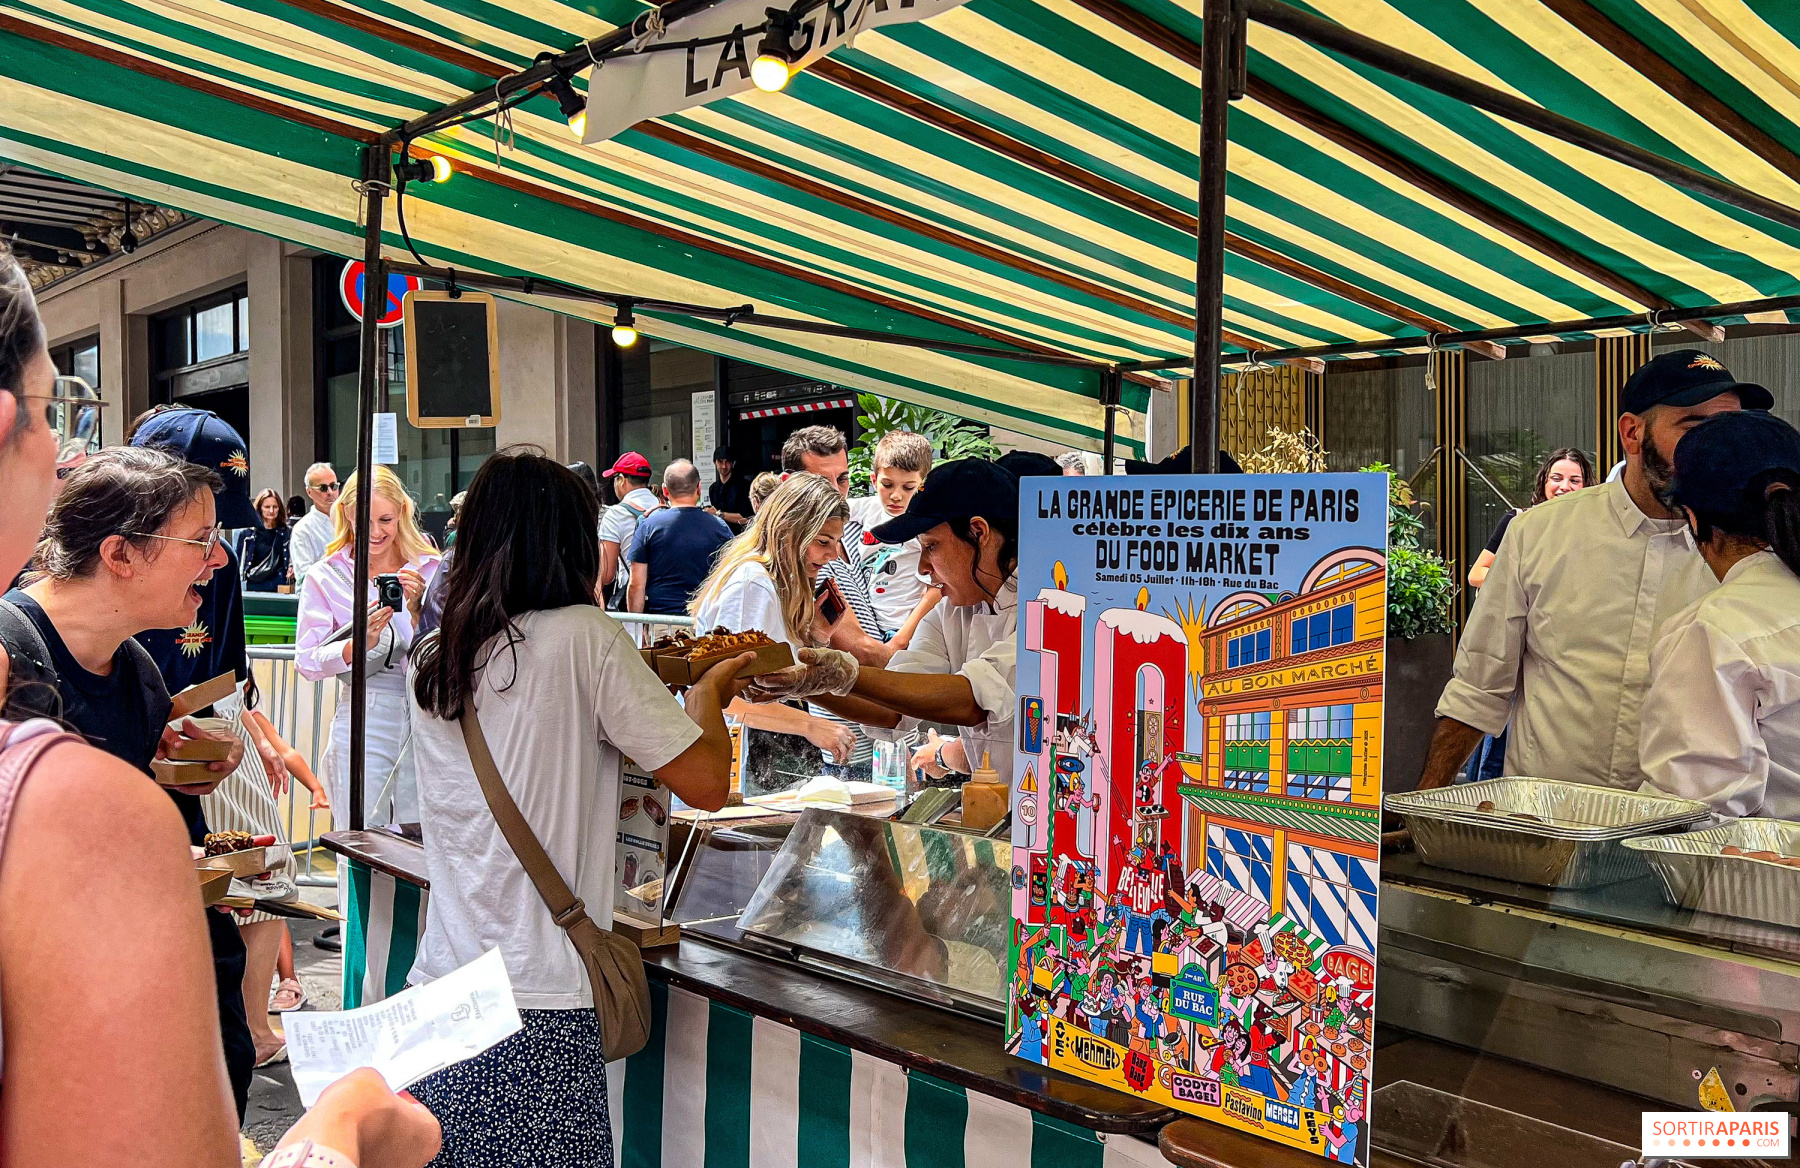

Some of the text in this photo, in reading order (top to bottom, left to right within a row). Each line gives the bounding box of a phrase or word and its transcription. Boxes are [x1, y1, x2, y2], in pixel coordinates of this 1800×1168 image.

[685, 24, 750, 97] LA
[1038, 489, 1061, 519] LA
[1067, 489, 1144, 520] GRANDE
[1253, 489, 1282, 522] DE
[1290, 488, 1359, 523] PARIS
[1072, 521, 1310, 540] célèbre les dix ans
[1096, 539, 1280, 576] DU FOOD MARKET
[1095, 572, 1279, 590] Samedi 05 Juillet 11h-18h Rue du Bac
[1207, 655, 1379, 696] AU BON MARCHÉ
[1022, 805, 1036, 817] 10
[1174, 997, 1213, 1016] DU BAC
[1183, 990, 1205, 1004] RUE
[1075, 1036, 1116, 1069] Mehmet
[1131, 1052, 1148, 1074] Bang
[1129, 1065, 1146, 1087] Bang
[1173, 1076, 1217, 1093] CODYS
[1178, 1088, 1217, 1103] BAGEL
[1224, 1092, 1263, 1121] Pastavino
[1265, 1102, 1299, 1127] MERSEA
